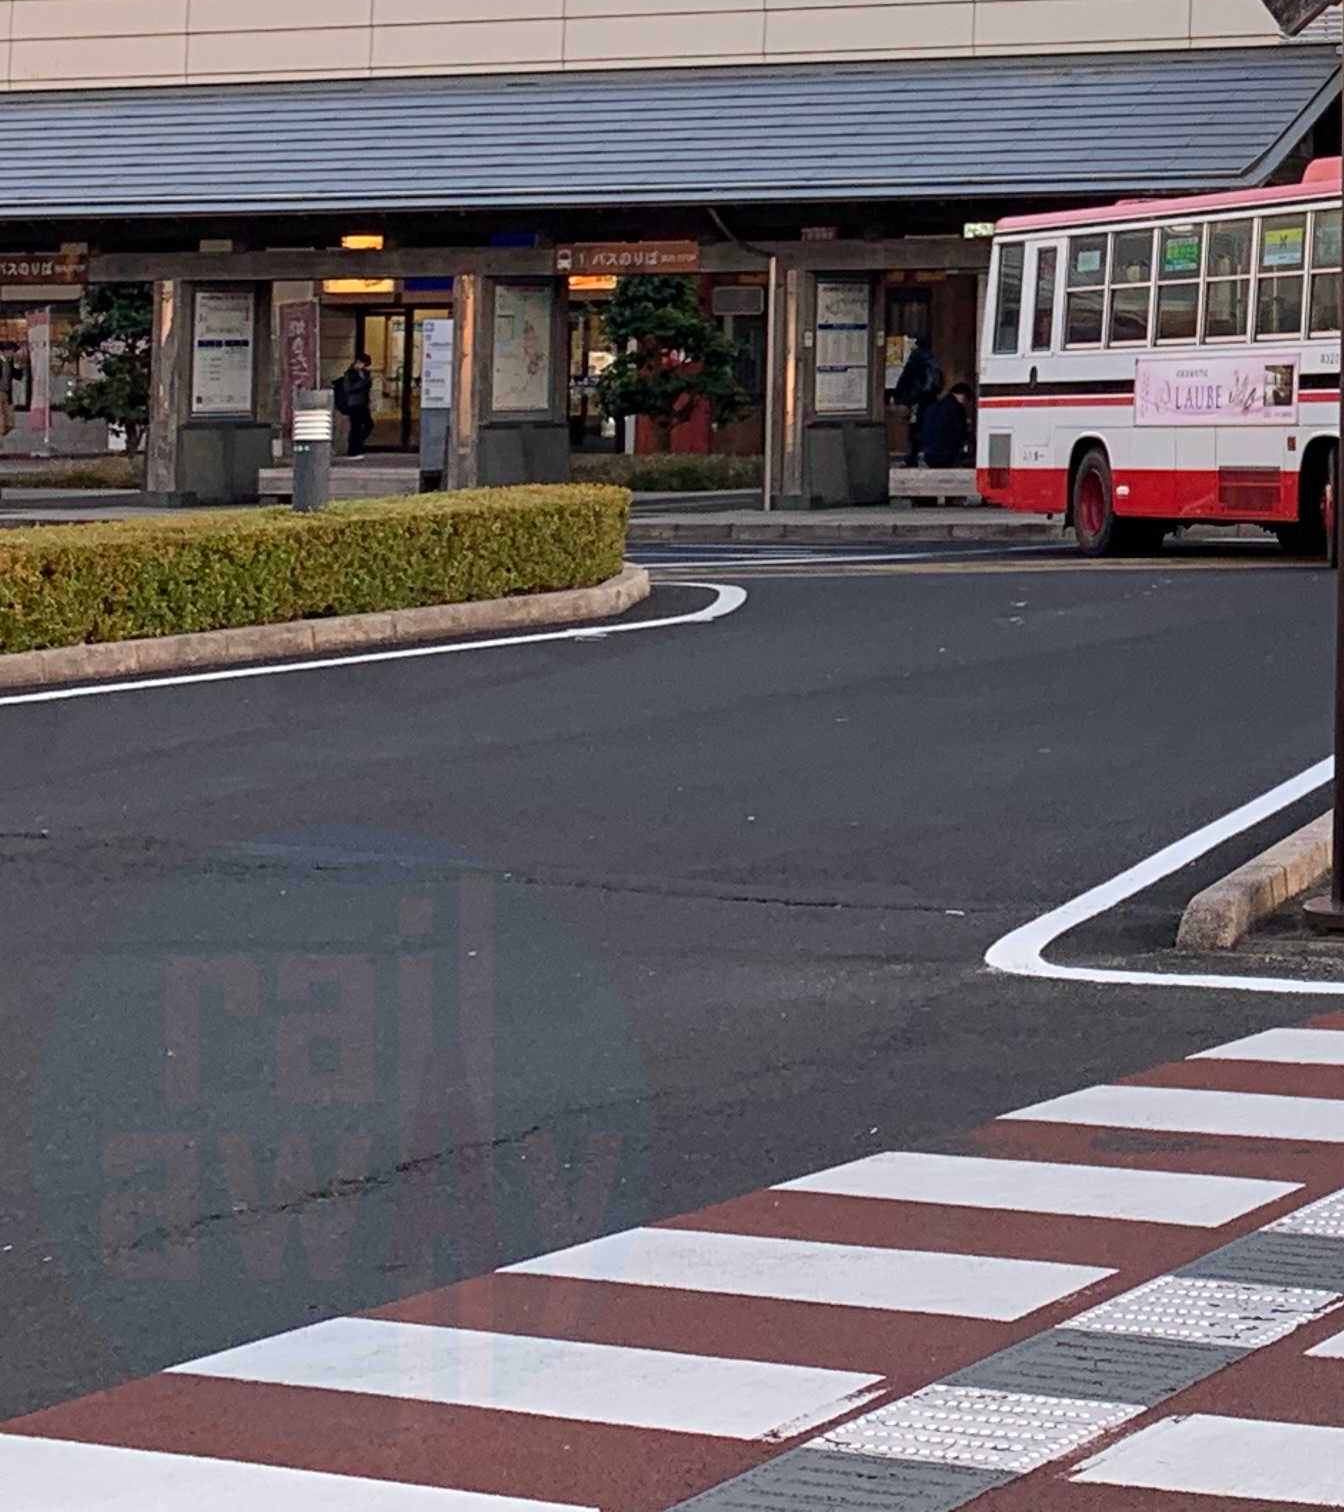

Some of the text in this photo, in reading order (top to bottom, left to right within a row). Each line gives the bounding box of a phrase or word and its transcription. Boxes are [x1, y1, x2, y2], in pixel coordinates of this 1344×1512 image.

[592, 251, 658, 266] バスのりば
[1176, 384, 1223, 409] LAUBE
